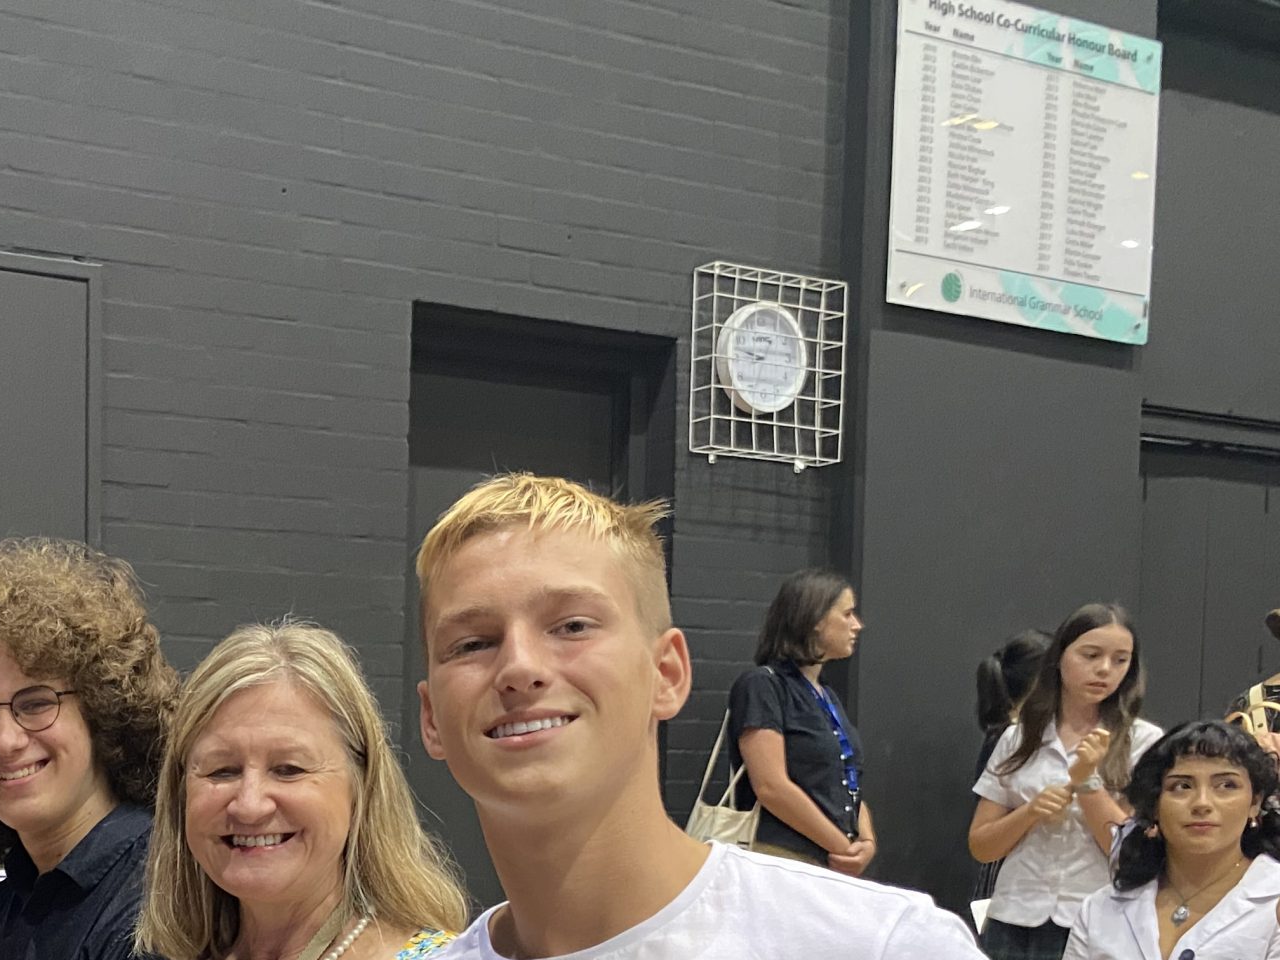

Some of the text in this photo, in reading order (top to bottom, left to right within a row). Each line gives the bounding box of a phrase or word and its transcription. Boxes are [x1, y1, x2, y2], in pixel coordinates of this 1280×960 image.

[928, 0, 1137, 62] High School Co-Curricular Honour Board
[969, 287, 1103, 321] International Grammar School
